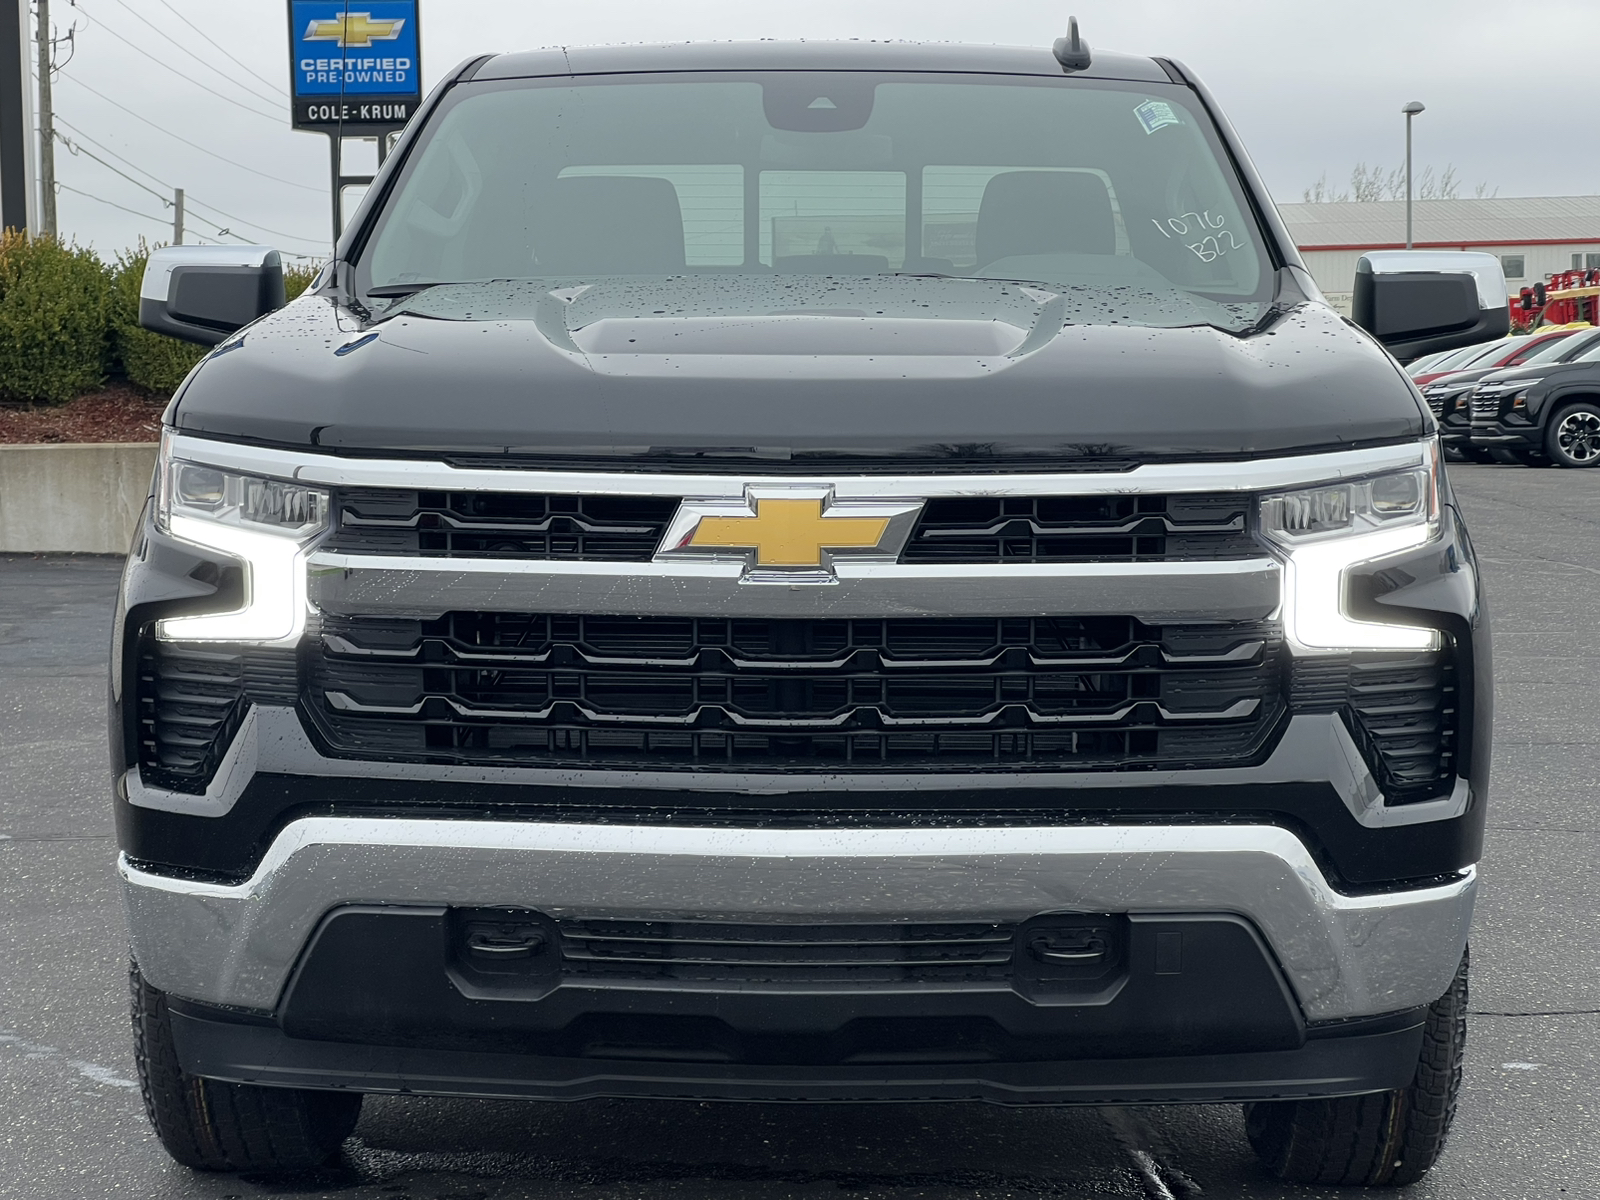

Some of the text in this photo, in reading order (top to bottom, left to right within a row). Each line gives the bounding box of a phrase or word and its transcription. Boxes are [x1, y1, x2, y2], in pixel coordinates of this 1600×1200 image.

[300, 58, 411, 71] CERTIFIED
[306, 71, 406, 83] PRE-OWNED
[308, 104, 406, 120] COLE-KRUM
[1151, 210, 1225, 239] 1076
